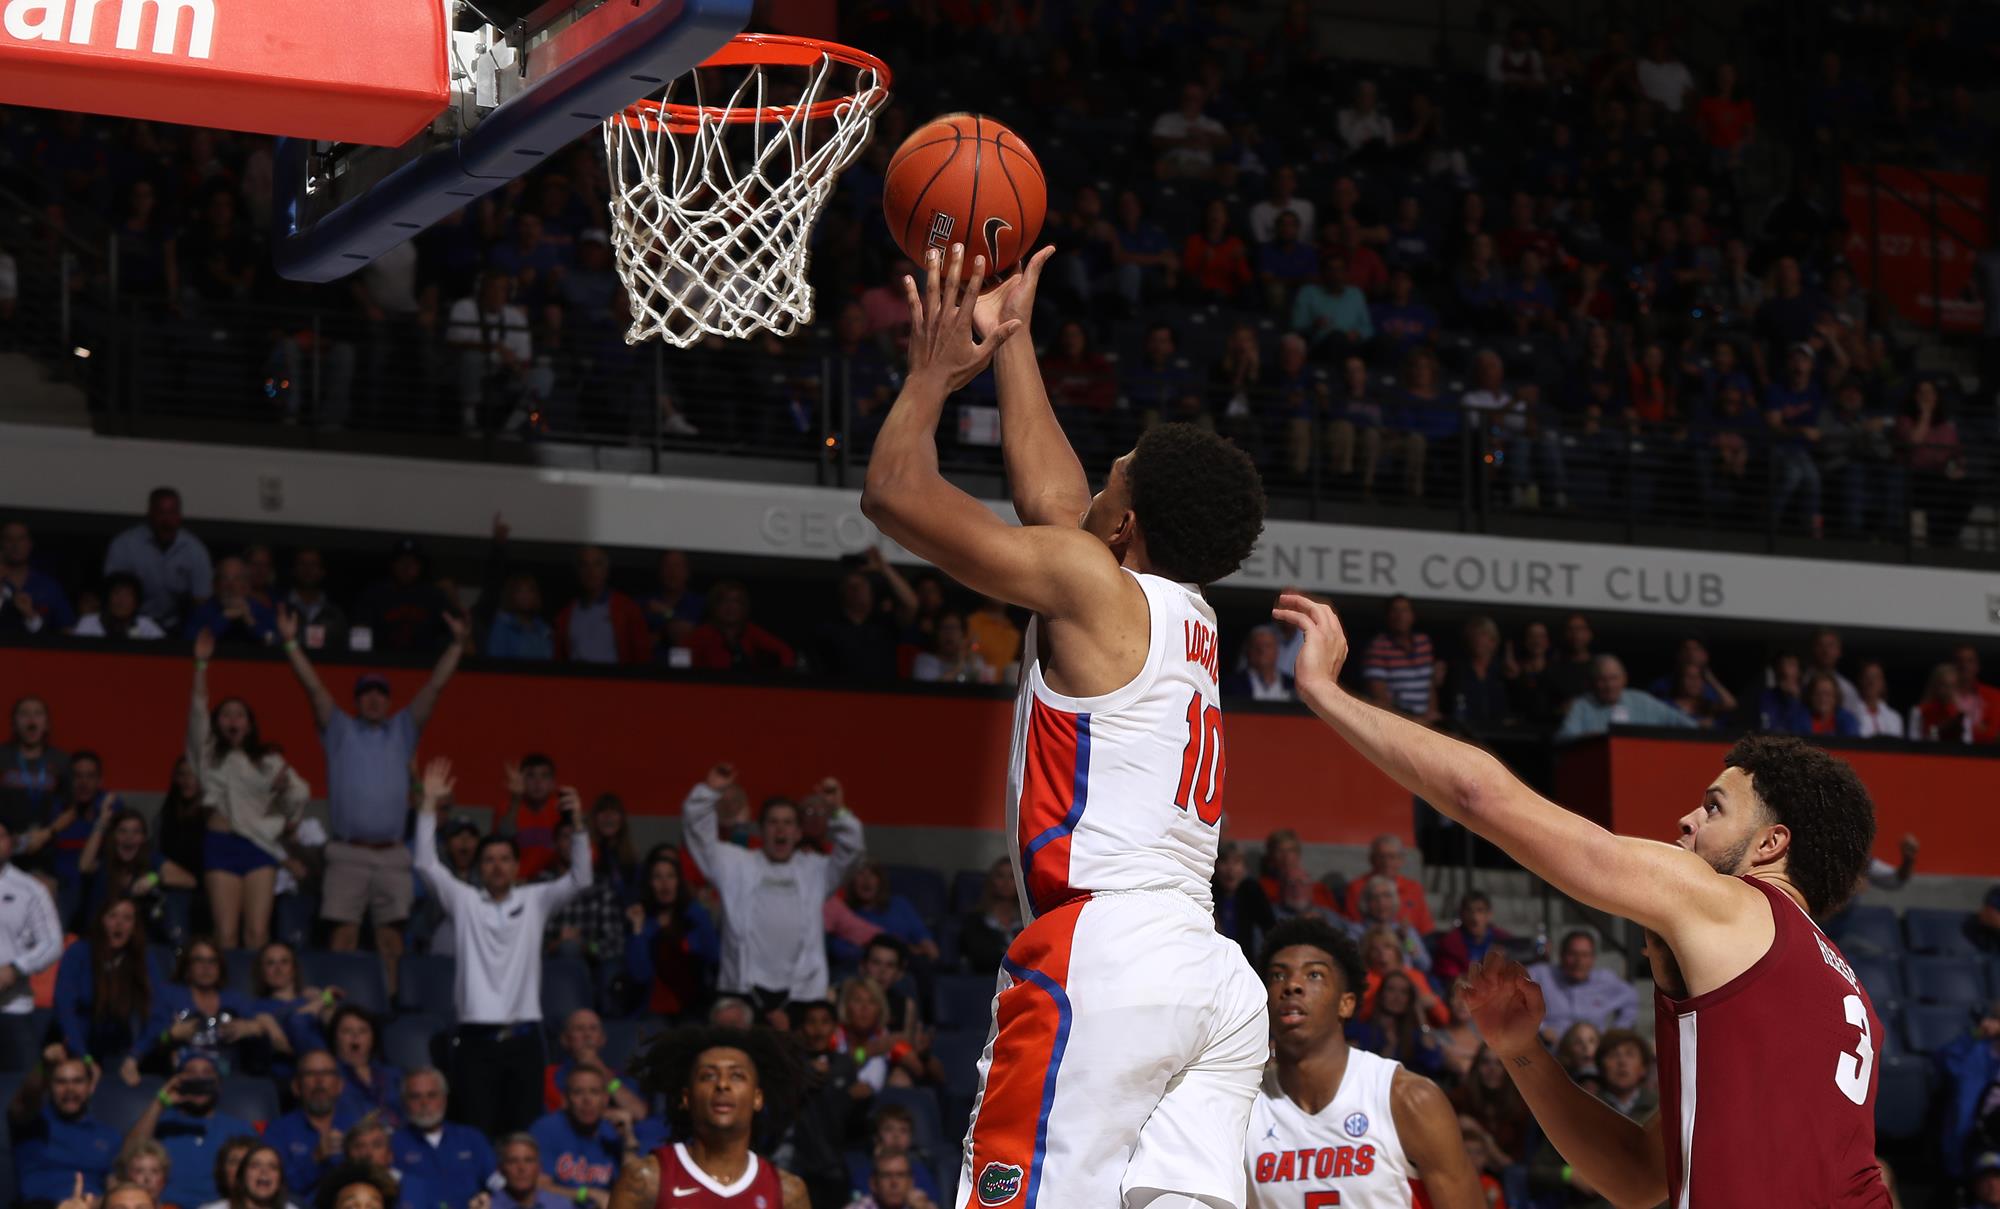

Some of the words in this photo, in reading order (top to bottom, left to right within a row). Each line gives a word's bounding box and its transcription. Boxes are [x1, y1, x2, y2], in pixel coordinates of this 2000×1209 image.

[926, 211, 955, 266] ELI
[760, 506, 870, 551] GEO
[1243, 543, 1397, 586] ENTER
[1420, 554, 1582, 598] COURT
[1604, 566, 1725, 608] CLUB
[1173, 689, 1226, 828] 10
[1834, 994, 1875, 1106] 3
[1255, 1144, 1377, 1184] GATORS
